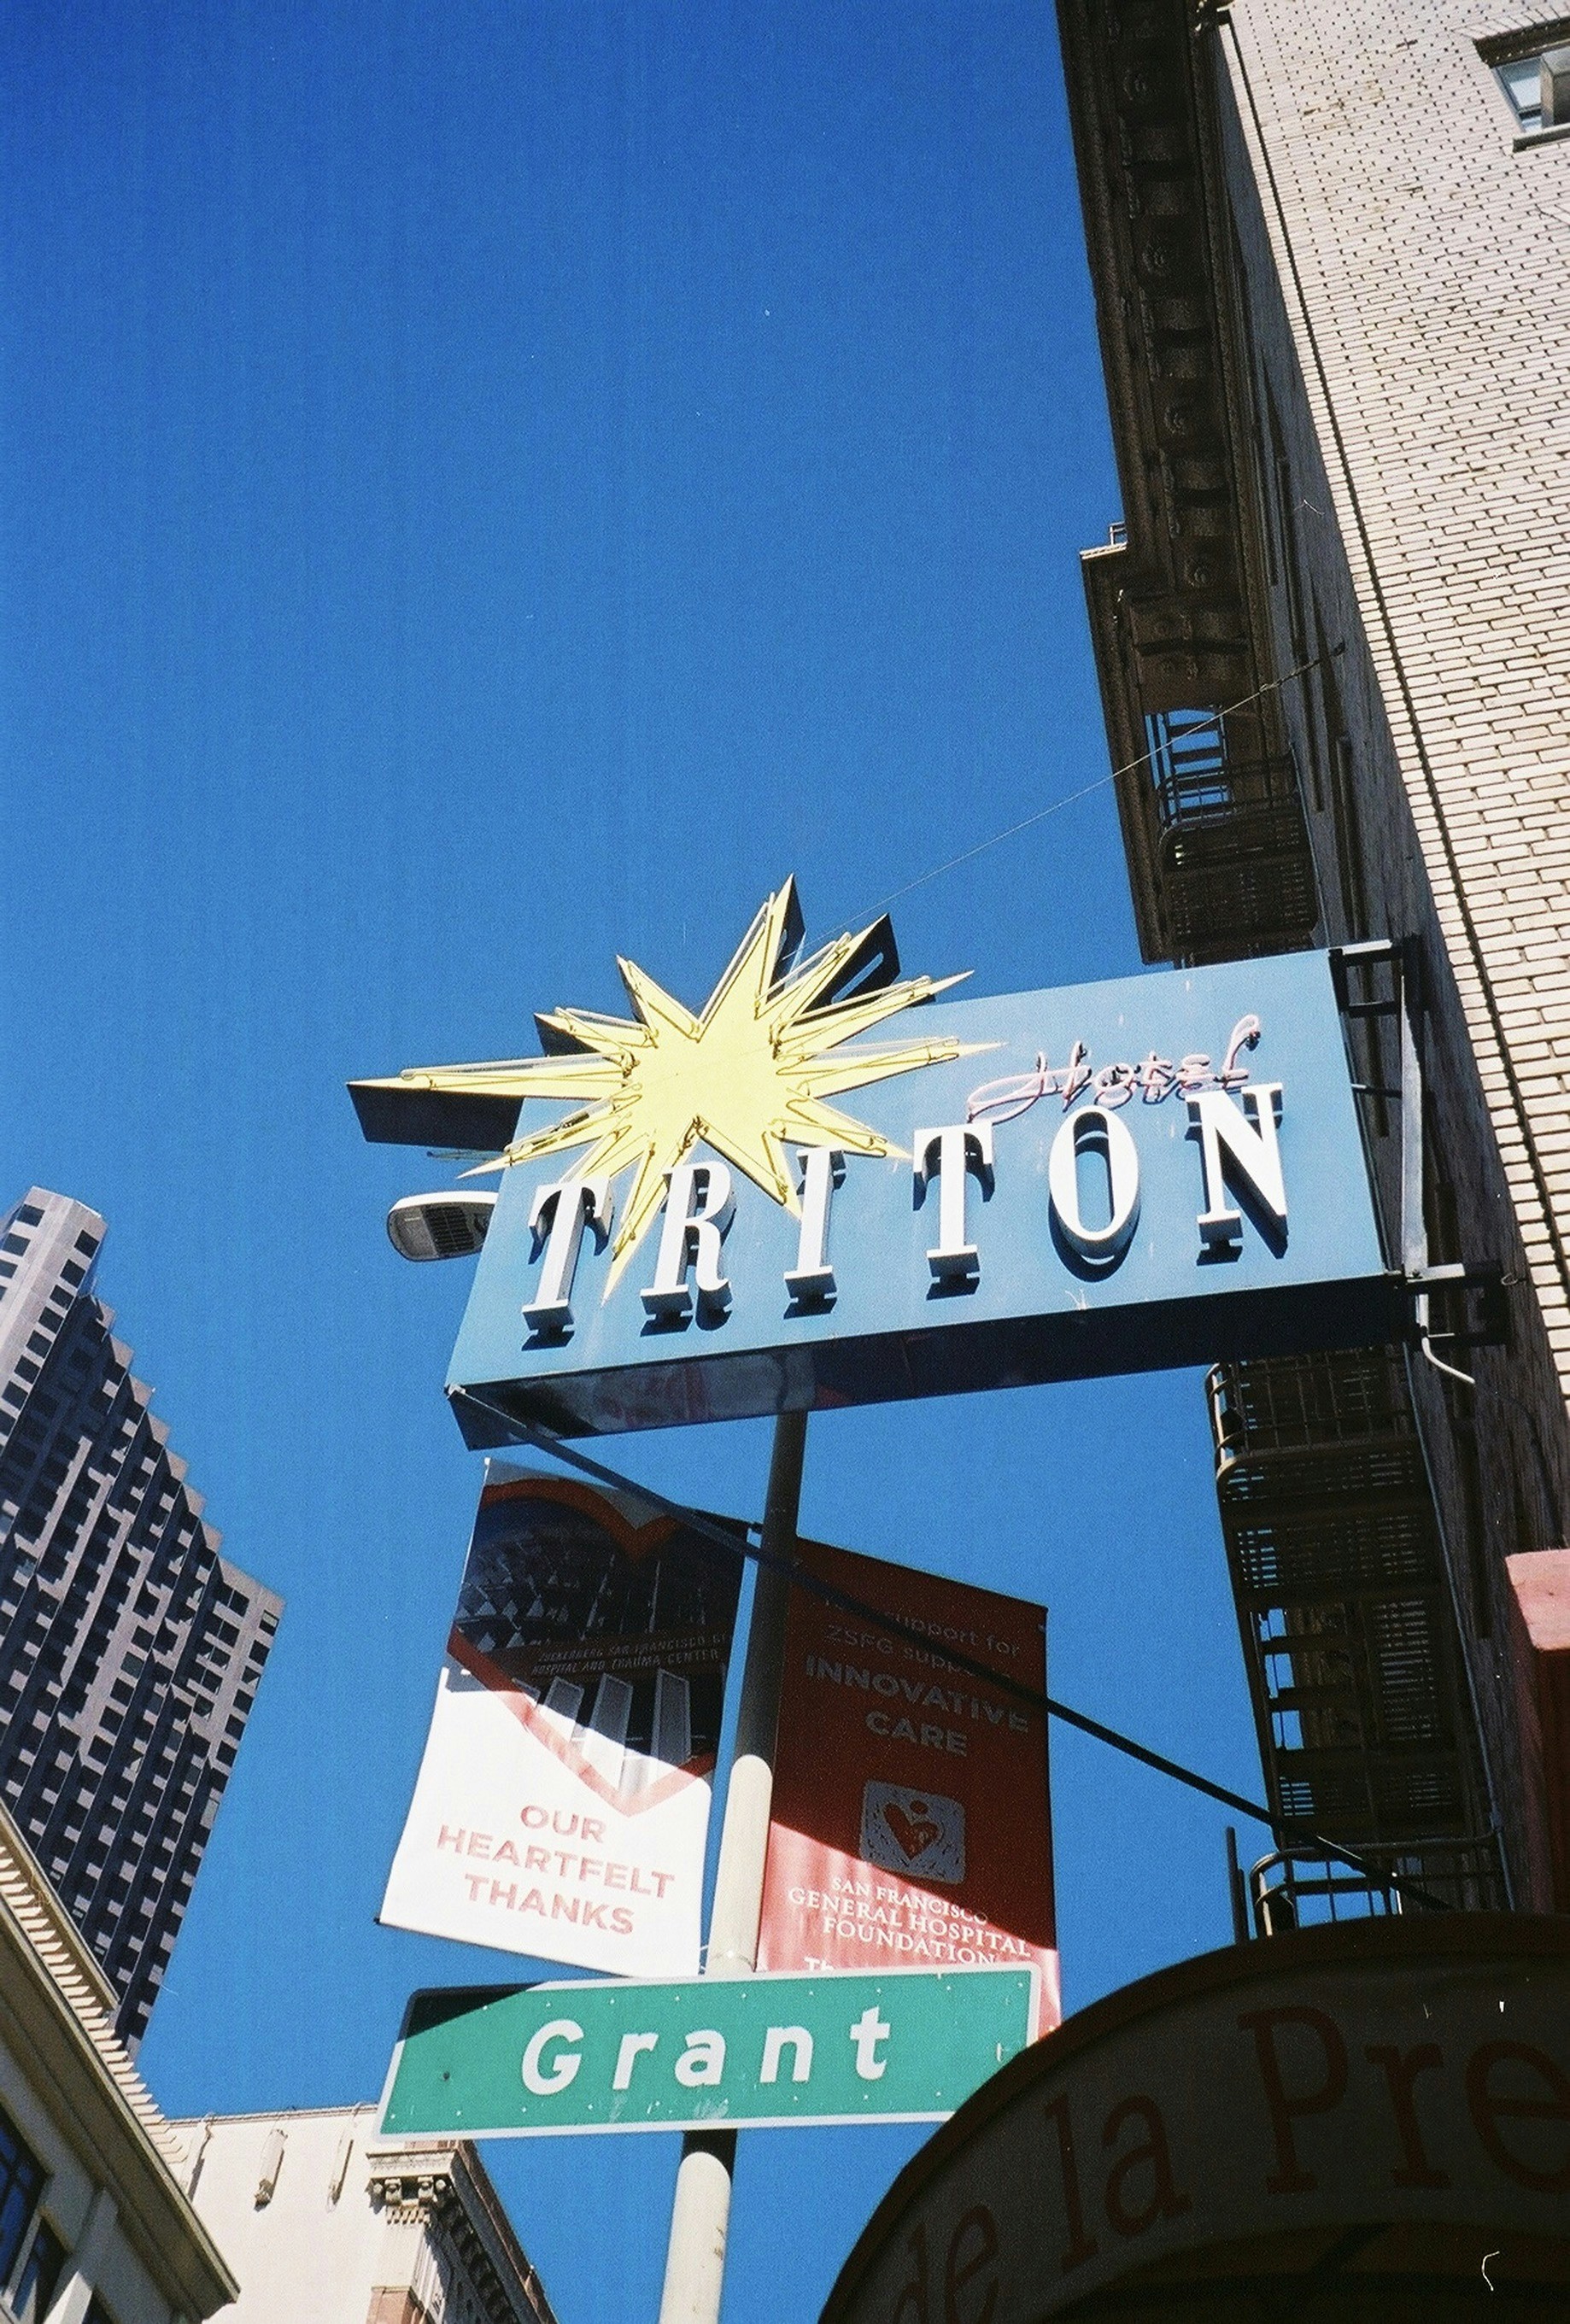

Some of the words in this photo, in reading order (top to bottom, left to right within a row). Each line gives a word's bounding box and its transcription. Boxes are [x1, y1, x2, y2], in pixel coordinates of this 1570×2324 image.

[967, 1015, 1261, 1124] Hotel
[521, 1082, 1289, 1332] TRITON
[530, 1661, 577, 1676] HOSPITAL
[612, 1654, 661, 1671] TRAUMA
[667, 1648, 719, 1665] CENTER
[823, 1624, 894, 1655] ZSFG
[985, 1633, 1022, 1658] for
[805, 1653, 1029, 1734] INNOVATIVE
[864, 1710, 968, 1757] CARE
[520, 1805, 607, 1843] OUR
[436, 1824, 676, 1899] HEARTFELT
[465, 1873, 635, 1935] THANKS
[788, 1887, 903, 1928] GENERAL
[908, 1911, 1032, 1958] HOSPITAL
[831, 1876, 869, 1898] SAN
[876, 1886, 989, 1926] FRANCISCO
[822, 1917, 997, 1964] FOUNDATION
[521, 2006, 891, 2096] Grant
[1045, 2091, 1193, 2275] la
